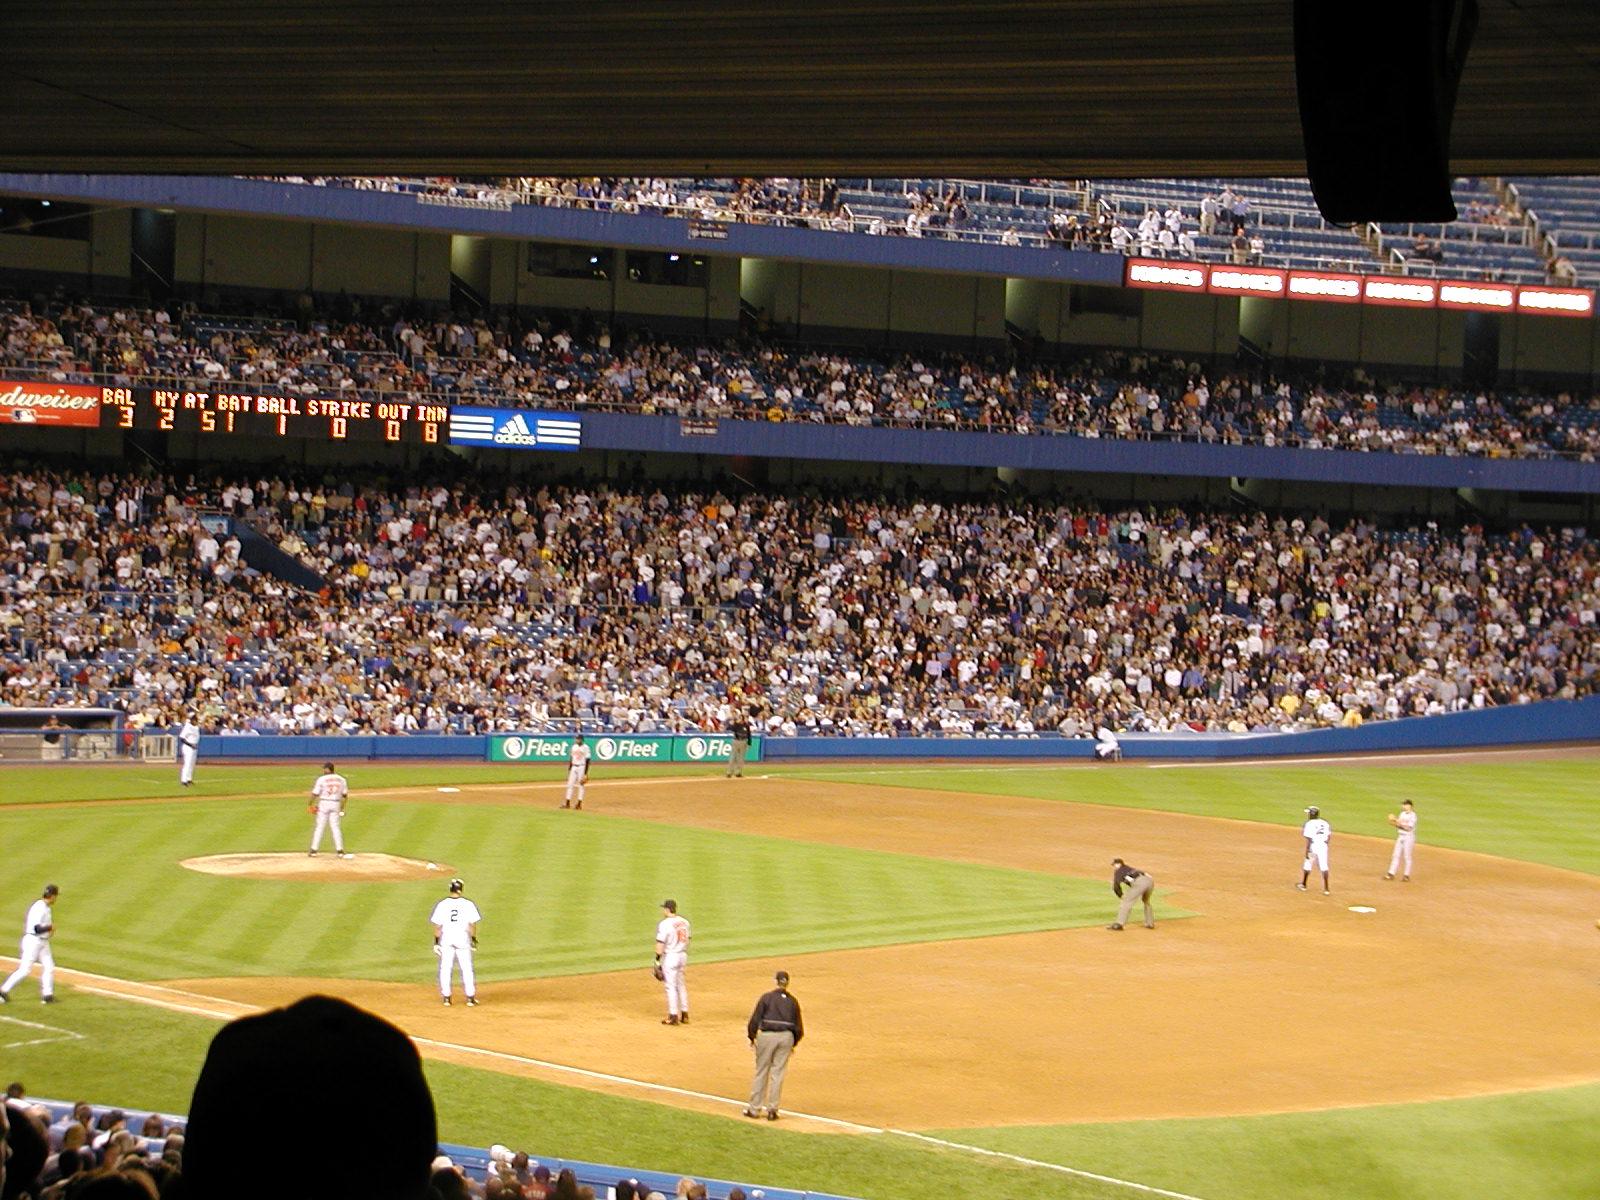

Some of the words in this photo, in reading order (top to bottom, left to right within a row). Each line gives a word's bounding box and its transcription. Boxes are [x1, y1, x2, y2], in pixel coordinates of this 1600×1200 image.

[0, 386, 98, 411] dweiser
[102, 387, 136, 406] BAL
[154, 390, 180, 408] NY
[184, 392, 209, 410] AT
[217, 394, 253, 413] BAT
[257, 396, 301, 416] BALL
[307, 399, 371, 418] STRIKE
[377, 403, 412, 422] OUT
[416, 405, 448, 422] INN
[118, 405, 134, 428] 3
[160, 408, 175, 430] 2
[278, 413, 288, 436] 1
[331, 417, 347, 439] 0
[387, 420, 402, 441] 0
[493, 432, 537, 446] adidas
[524, 739, 569, 757] Fleet
[616, 740, 660, 758] Fleet
[707, 740, 732, 757] Fle
[450, 909, 459, 922] 2
